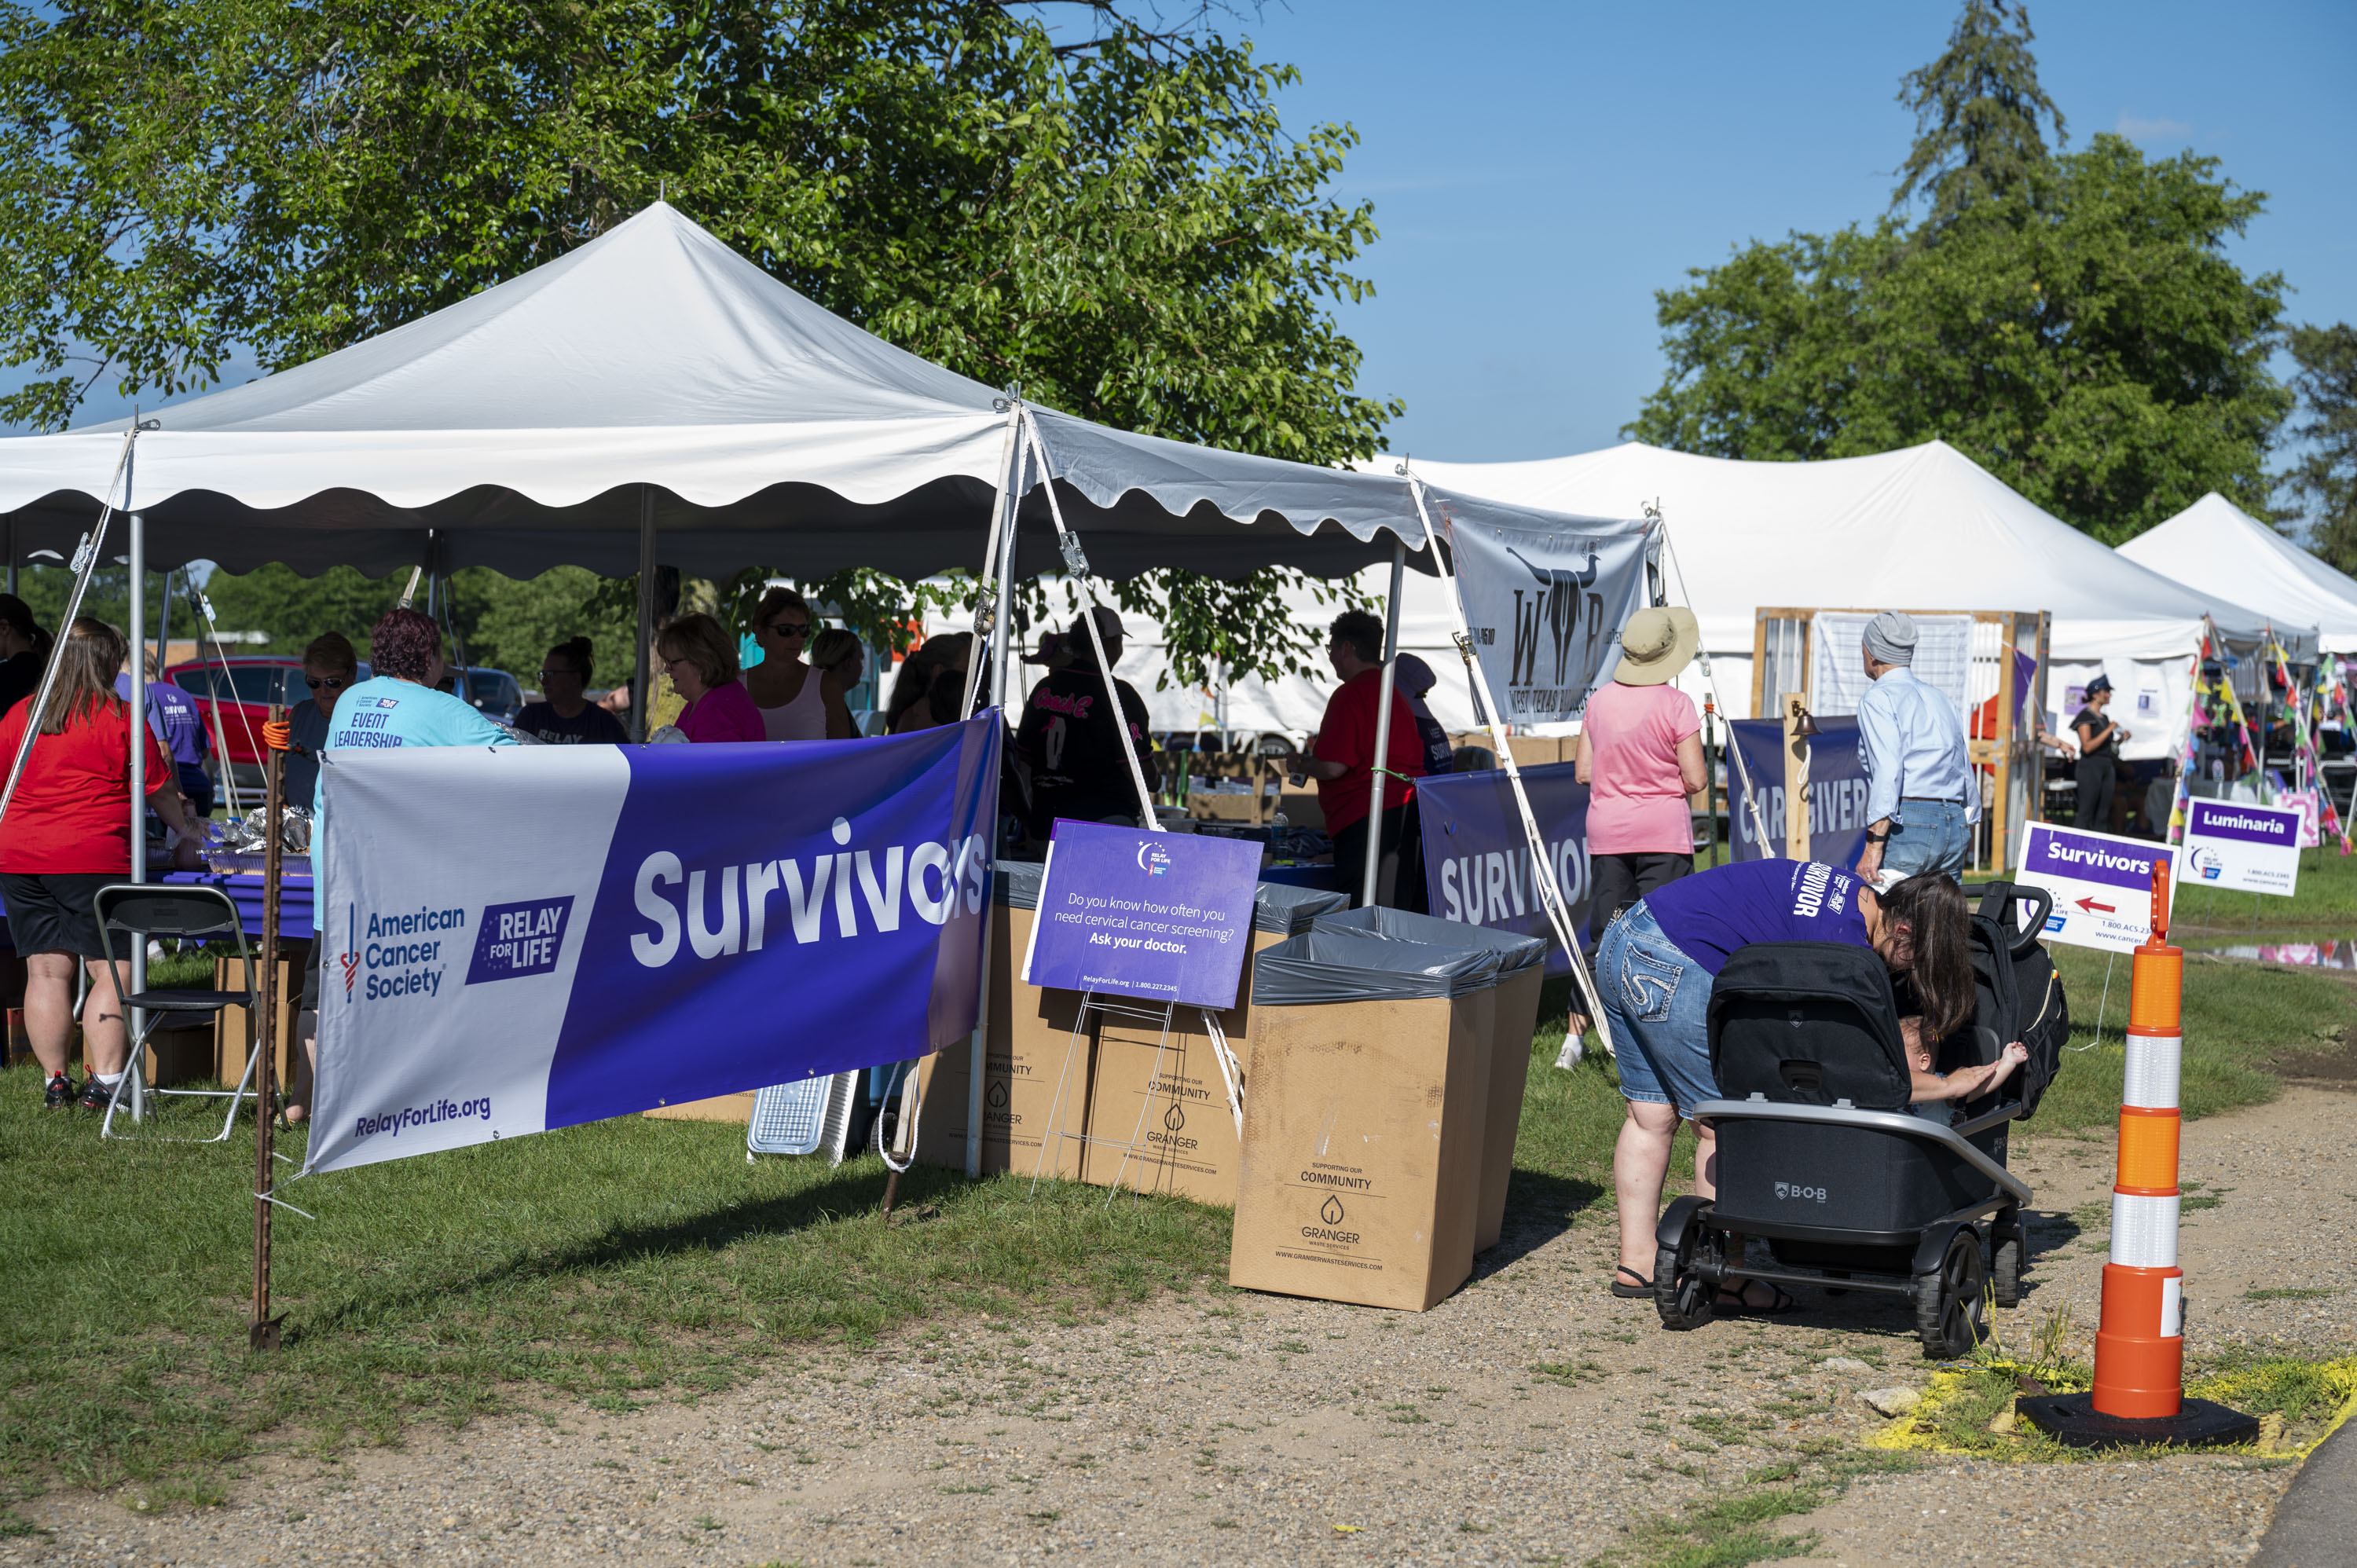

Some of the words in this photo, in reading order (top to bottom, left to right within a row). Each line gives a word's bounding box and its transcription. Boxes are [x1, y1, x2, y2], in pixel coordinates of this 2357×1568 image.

[1033, 687, 1076, 714] Coach
[1509, 690, 1530, 713] WEST
[1533, 689, 1557, 713] TEXAS
[351, 712, 390, 729] EVENT
[334, 730, 403, 748] LEADERSHIP
[537, 728, 584, 744] RELAY
[2203, 810, 2285, 834] Luminaria
[2047, 841, 2150, 875] Survivors
[629, 816, 986, 968] Survivors
[1793, 862, 1832, 918] SURVIVOR
[1069, 892, 1084, 905] Do
[1086, 897, 1106, 910] you
[1109, 896, 1142, 910] know
[1143, 900, 1169, 914] how
[1171, 903, 1200, 918] often
[1202, 910, 1226, 922] you
[366, 905, 465, 940] American
[499, 906, 563, 940] RELAY
[1055, 911, 1083, 924] need
[1085, 914, 1128, 929] cervical
[1130, 921, 1169, 933] cancer
[1171, 924, 1234, 943] screening?
[2102, 921, 2151, 935] 1.800.ACS.23
[490, 944, 511, 959] FOR
[511, 937, 552, 969] LIFE
[1089, 932, 1112, 945] Ask
[1113, 936, 1142, 949] your
[1144, 939, 1187, 954] doctor.
[365, 940, 441, 969] Cancer
[366, 965, 443, 1000] Society
[1083, 975, 1130, 987] RelayForLife.org
[1135, 981, 1178, 992] 1.800.227.2345
[985, 1062, 1032, 1075] MMUNITY
[1158, 1072, 1190, 1083] SUPPORTING
[1148, 1080, 1211, 1101] COMMUNITY
[354, 1097, 491, 1138] RelayForLife.org
[1146, 1131, 1197, 1149] GRANGER
[1168, 1147, 1189, 1156] SERVICES
[1123, 1152, 1217, 1175] WWW.GRANGERWASTESERVICES.COM
[1312, 1162, 1349, 1173] SUPPORTING
[1300, 1171, 1372, 1190] COMMUNITY
[1301, 1226, 1360, 1244] GRANGER
[1275, 1251, 1383, 1271] WWW.GRANGERWASTESERVICES.COM
